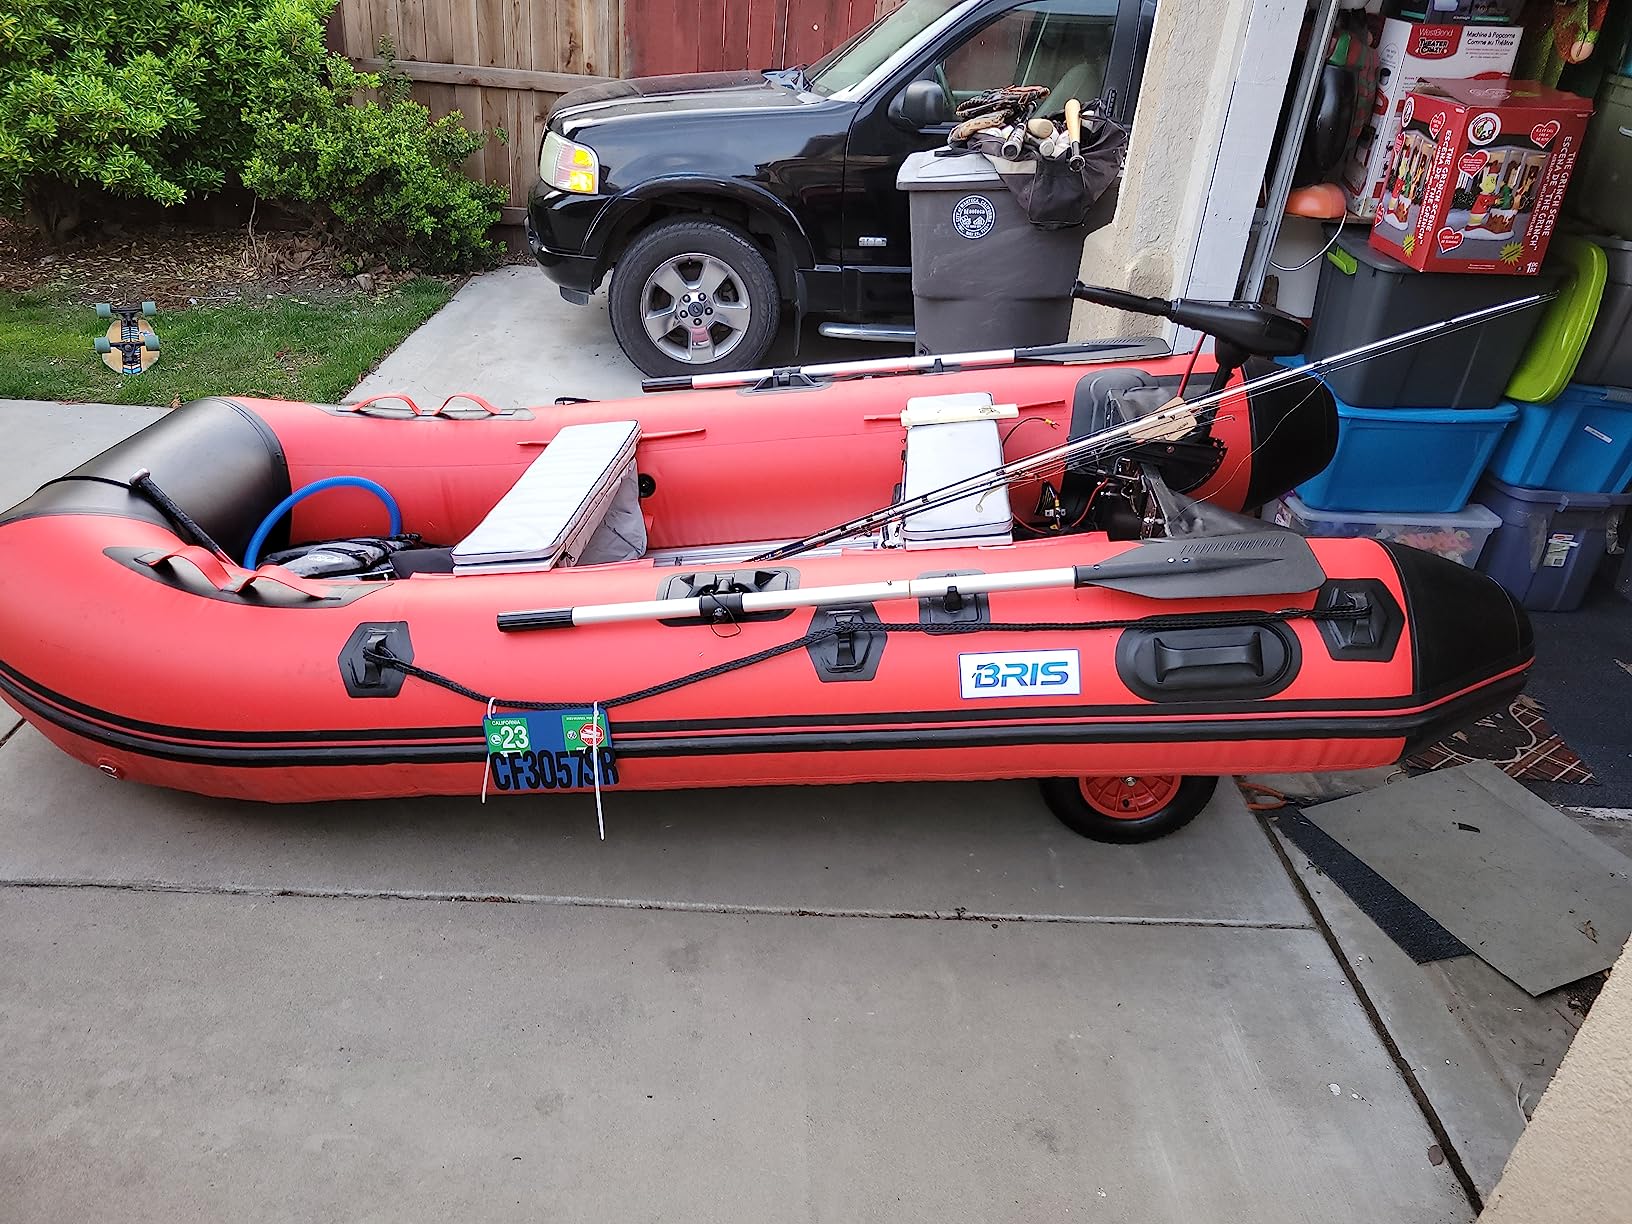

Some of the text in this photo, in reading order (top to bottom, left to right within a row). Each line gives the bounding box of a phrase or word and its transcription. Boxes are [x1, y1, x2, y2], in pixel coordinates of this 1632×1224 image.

[1419, 38, 1447, 47] THEATER
[1438, 130, 1452, 166] ESCENA
[1444, 147, 1454, 166] THE
[1556, 136, 1572, 171] ESCENA
[1434, 168, 1443, 180] DE
[1434, 168, 1449, 205] GRINCH
[1550, 174, 1559, 187] DE
[1542, 151, 1576, 237] THE GRINCH SCENE
[1426, 205, 1438, 232] SCENE
[972, 661, 1069, 688] BRIS
[500, 725, 529, 749] 23
[490, 747, 620, 790] CF3057SR
